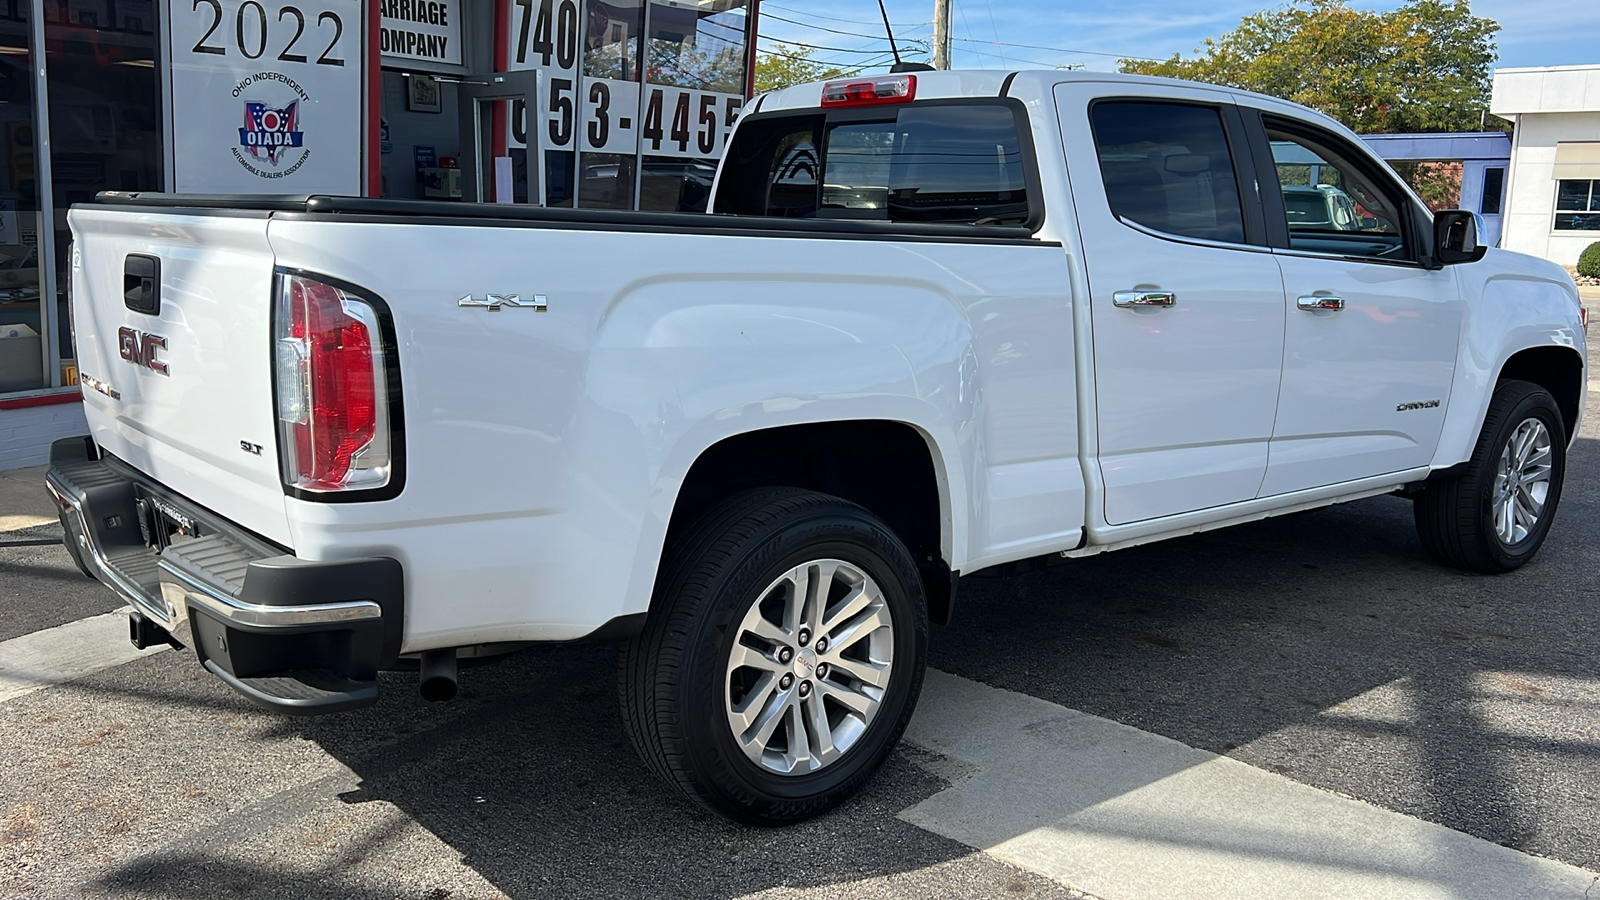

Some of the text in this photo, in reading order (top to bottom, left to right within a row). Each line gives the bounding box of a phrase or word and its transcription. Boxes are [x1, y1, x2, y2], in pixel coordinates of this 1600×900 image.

[380, 0, 448, 26] ARRIAGE
[192, 0, 345, 67] 2022
[380, 28, 448, 58] OMPANY
[516, 0, 577, 70] 740
[232, 72, 310, 102] OHIO INDEPENDENT
[247, 132, 293, 145] OIADA
[231, 147, 311, 179] AUTOMOBILE DEALERS ASSOCIATION
[118, 326, 170, 377] GMC
[1396, 399, 1440, 412] CANYON
[240, 439, 263, 457] SLT
[797, 656, 814, 671] GMC
